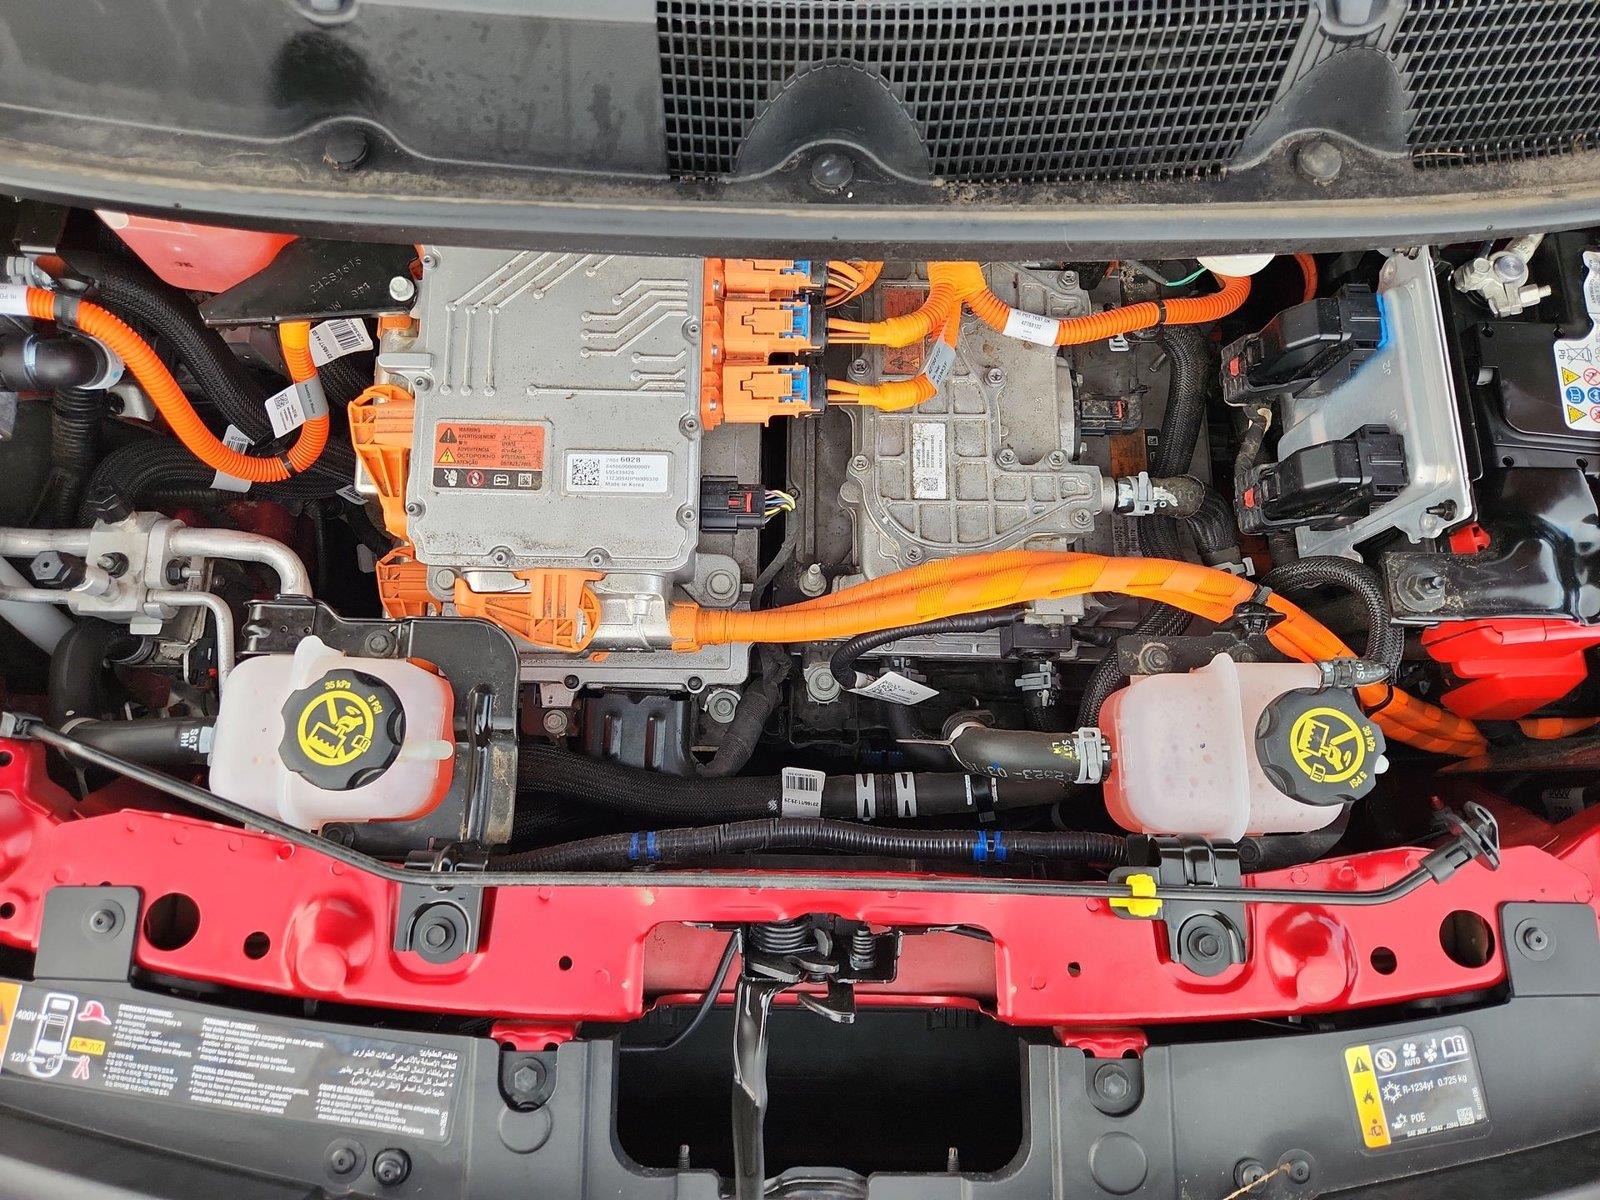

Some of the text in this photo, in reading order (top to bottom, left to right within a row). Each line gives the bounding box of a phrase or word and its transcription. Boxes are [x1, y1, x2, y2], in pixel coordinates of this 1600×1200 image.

[180, 732, 190, 747] RH
[188, 728, 200, 752] SGT
[15, 1008, 37, 1022] 400V
[1403, 1056, 1421, 1067] AUTO
[1436, 1074, 1457, 1086] 0.725
[1457, 1075, 1468, 1085] kg
[1409, 1111, 1426, 1123] POE
